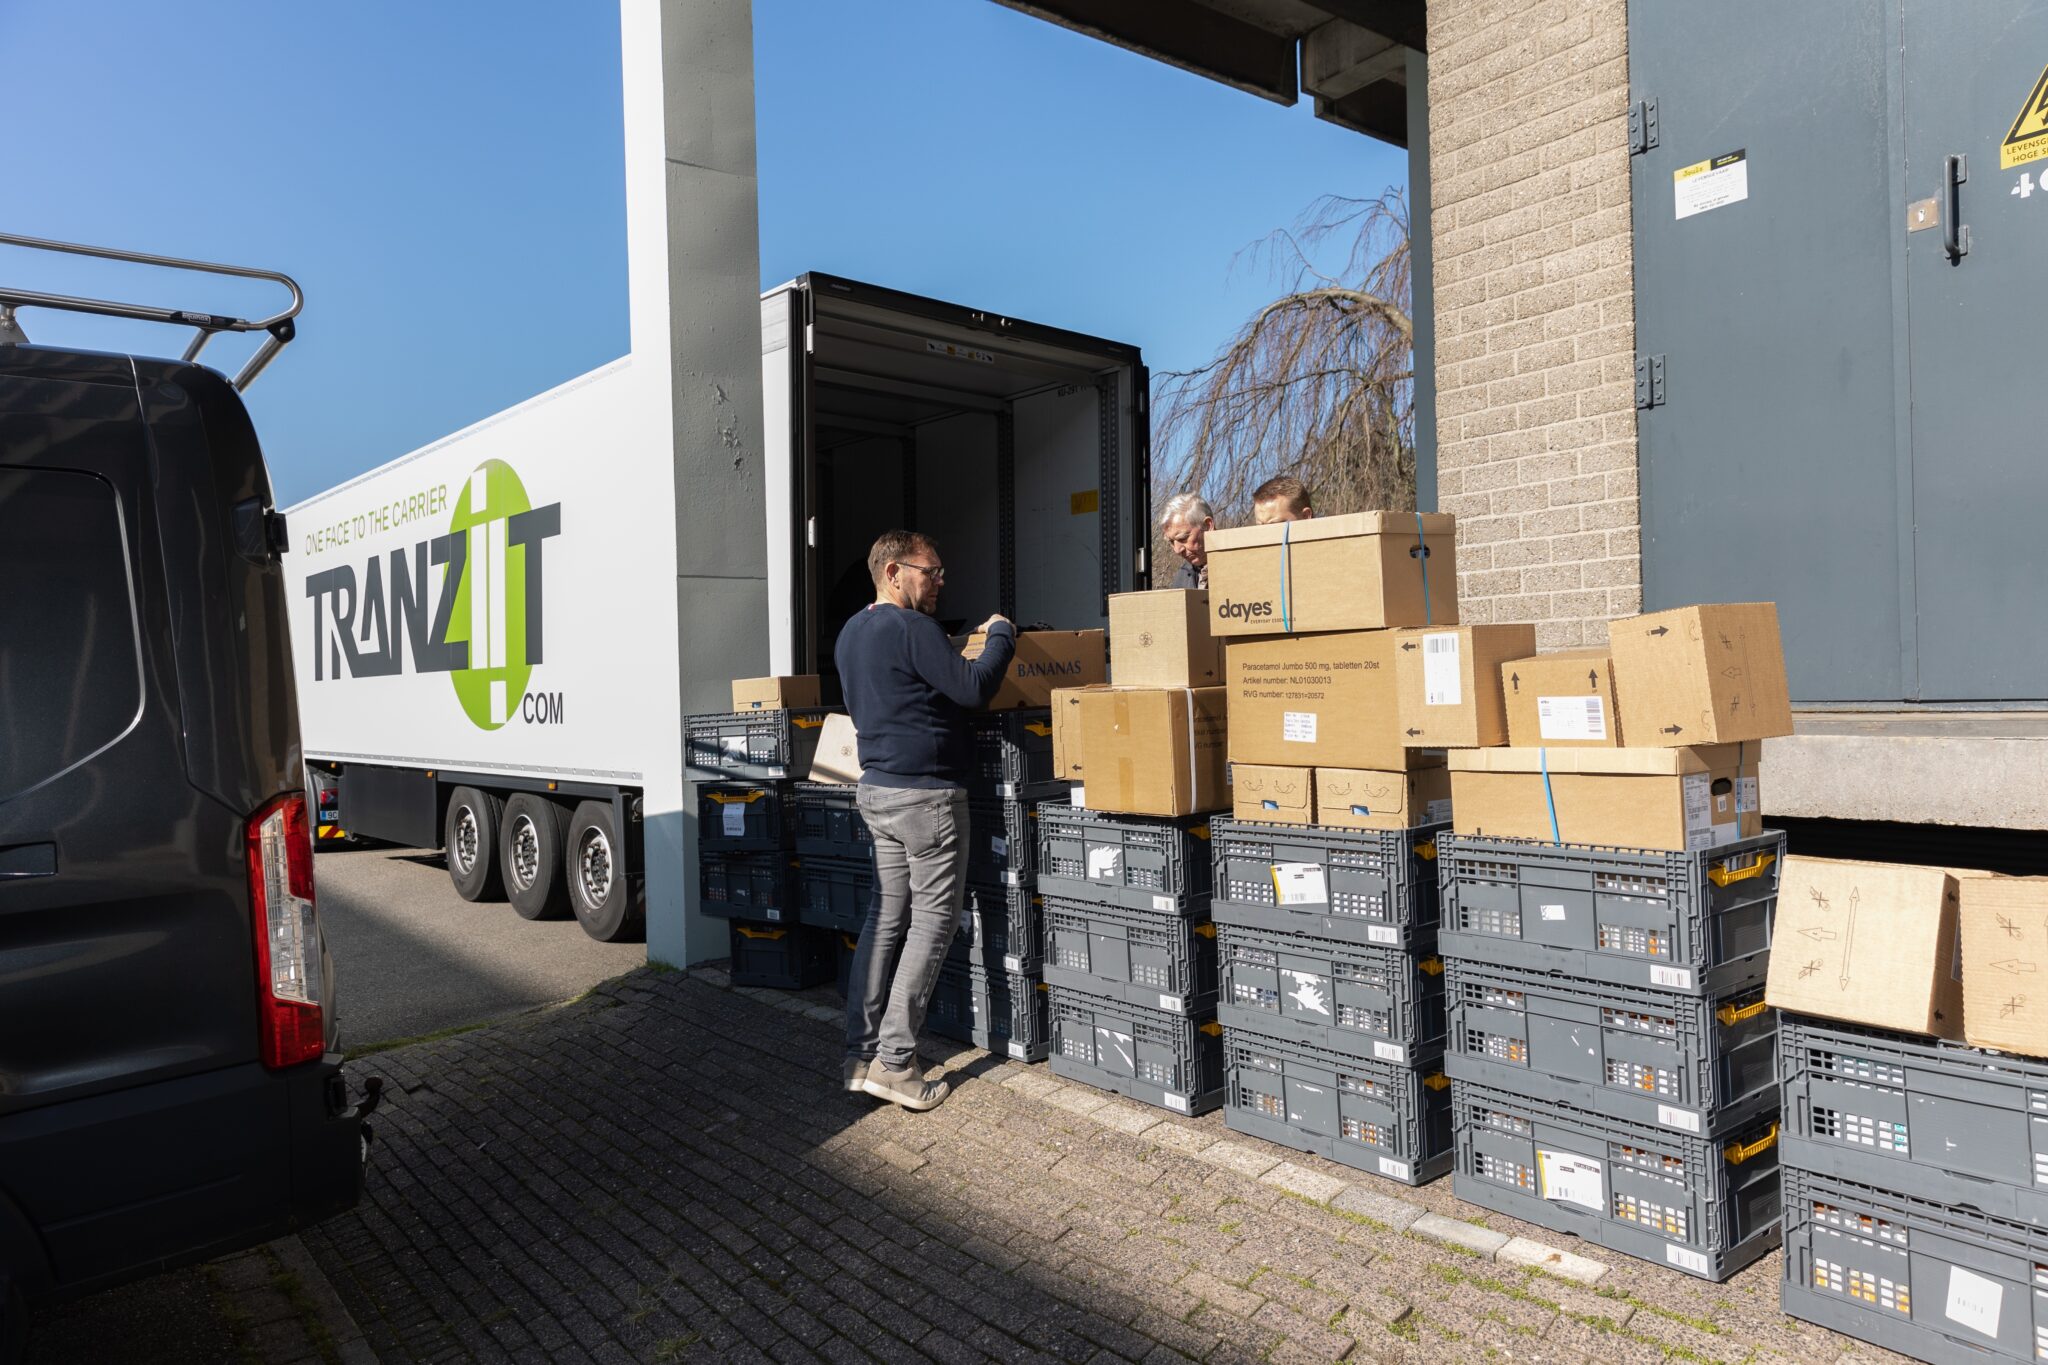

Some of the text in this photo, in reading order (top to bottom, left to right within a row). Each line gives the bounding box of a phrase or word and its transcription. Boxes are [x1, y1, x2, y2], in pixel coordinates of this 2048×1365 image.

[2007, 138, 2048, 155] LEVENSG
[2013, 150, 2038, 162] HOGE
[306, 484, 447, 556] ONE FACE TO THE CARRIER
[1218, 598, 1272, 622] dayes
[1018, 660, 1082, 677] BANANAS
[1282, 662, 1303, 670] Jumbo
[1305, 662, 1317, 670] 500
[1319, 663, 1331, 671] mg,
[1333, 661, 1362, 670] tabletten
[1364, 661, 1379, 670] 20st
[1243, 690, 1257, 698] RVG
